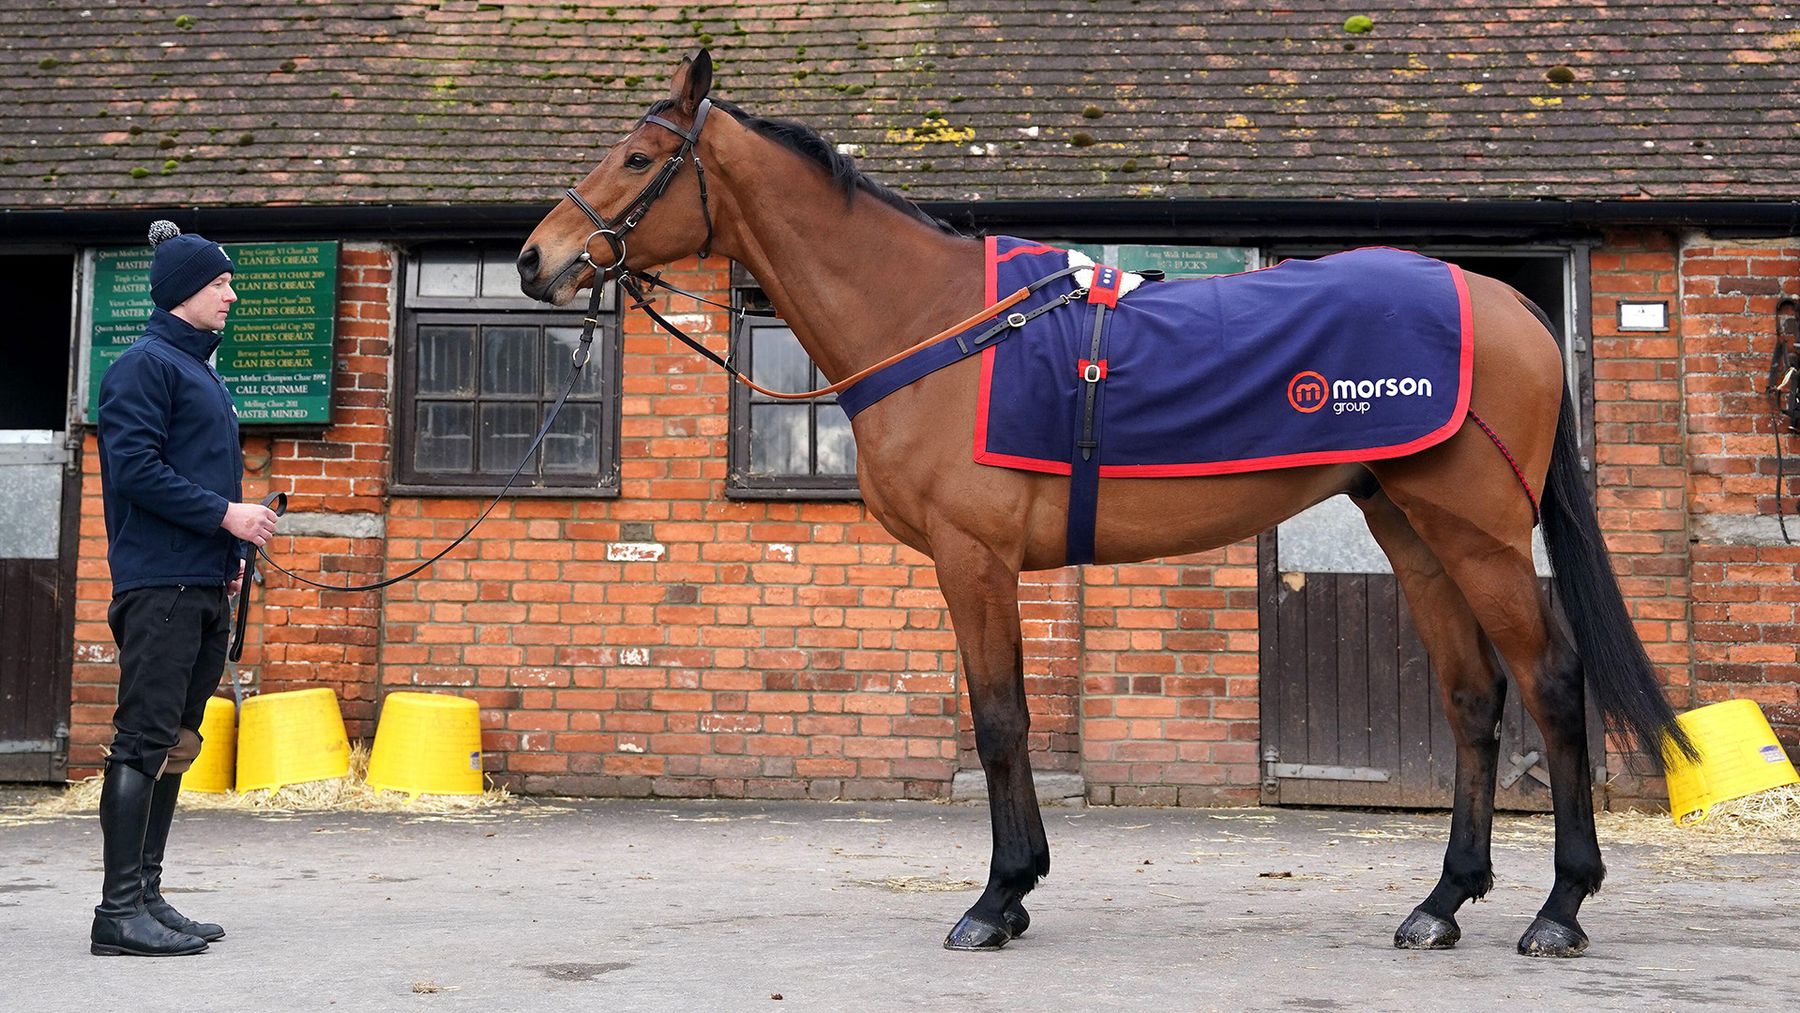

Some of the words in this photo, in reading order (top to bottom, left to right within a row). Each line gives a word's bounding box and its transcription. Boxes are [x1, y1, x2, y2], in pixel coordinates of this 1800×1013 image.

[116, 261, 150, 269] MASTER
[238, 257, 262, 265] CLAN
[265, 256, 280, 264] DES
[282, 256, 319, 264] OBEAUX
[112, 284, 146, 292] MASTER
[236, 282, 260, 290] CLAN
[280, 281, 315, 289] OBEAUX
[112, 308, 145, 317] MASTER
[236, 308, 260, 316] CLAN
[263, 307, 278, 315] DES
[280, 306, 315, 314] OBEAUX
[95, 325, 113, 333] Queen
[288, 323, 301, 331] Cup
[234, 334, 258, 342] CLAN
[260, 333, 276, 341] DES
[278, 332, 314, 340] OBEAUX
[233, 360, 258, 368] CLAN
[277, 359, 313, 367] OBEAUX
[263, 374, 292, 382] Champion
[236, 386, 258, 394] CALL
[261, 385, 308, 396] EQUINAME
[1332, 377, 1432, 399] morson
[244, 400, 266, 408] Melling
[1333, 402, 1370, 415] group
[271, 410, 308, 418] MINDED
